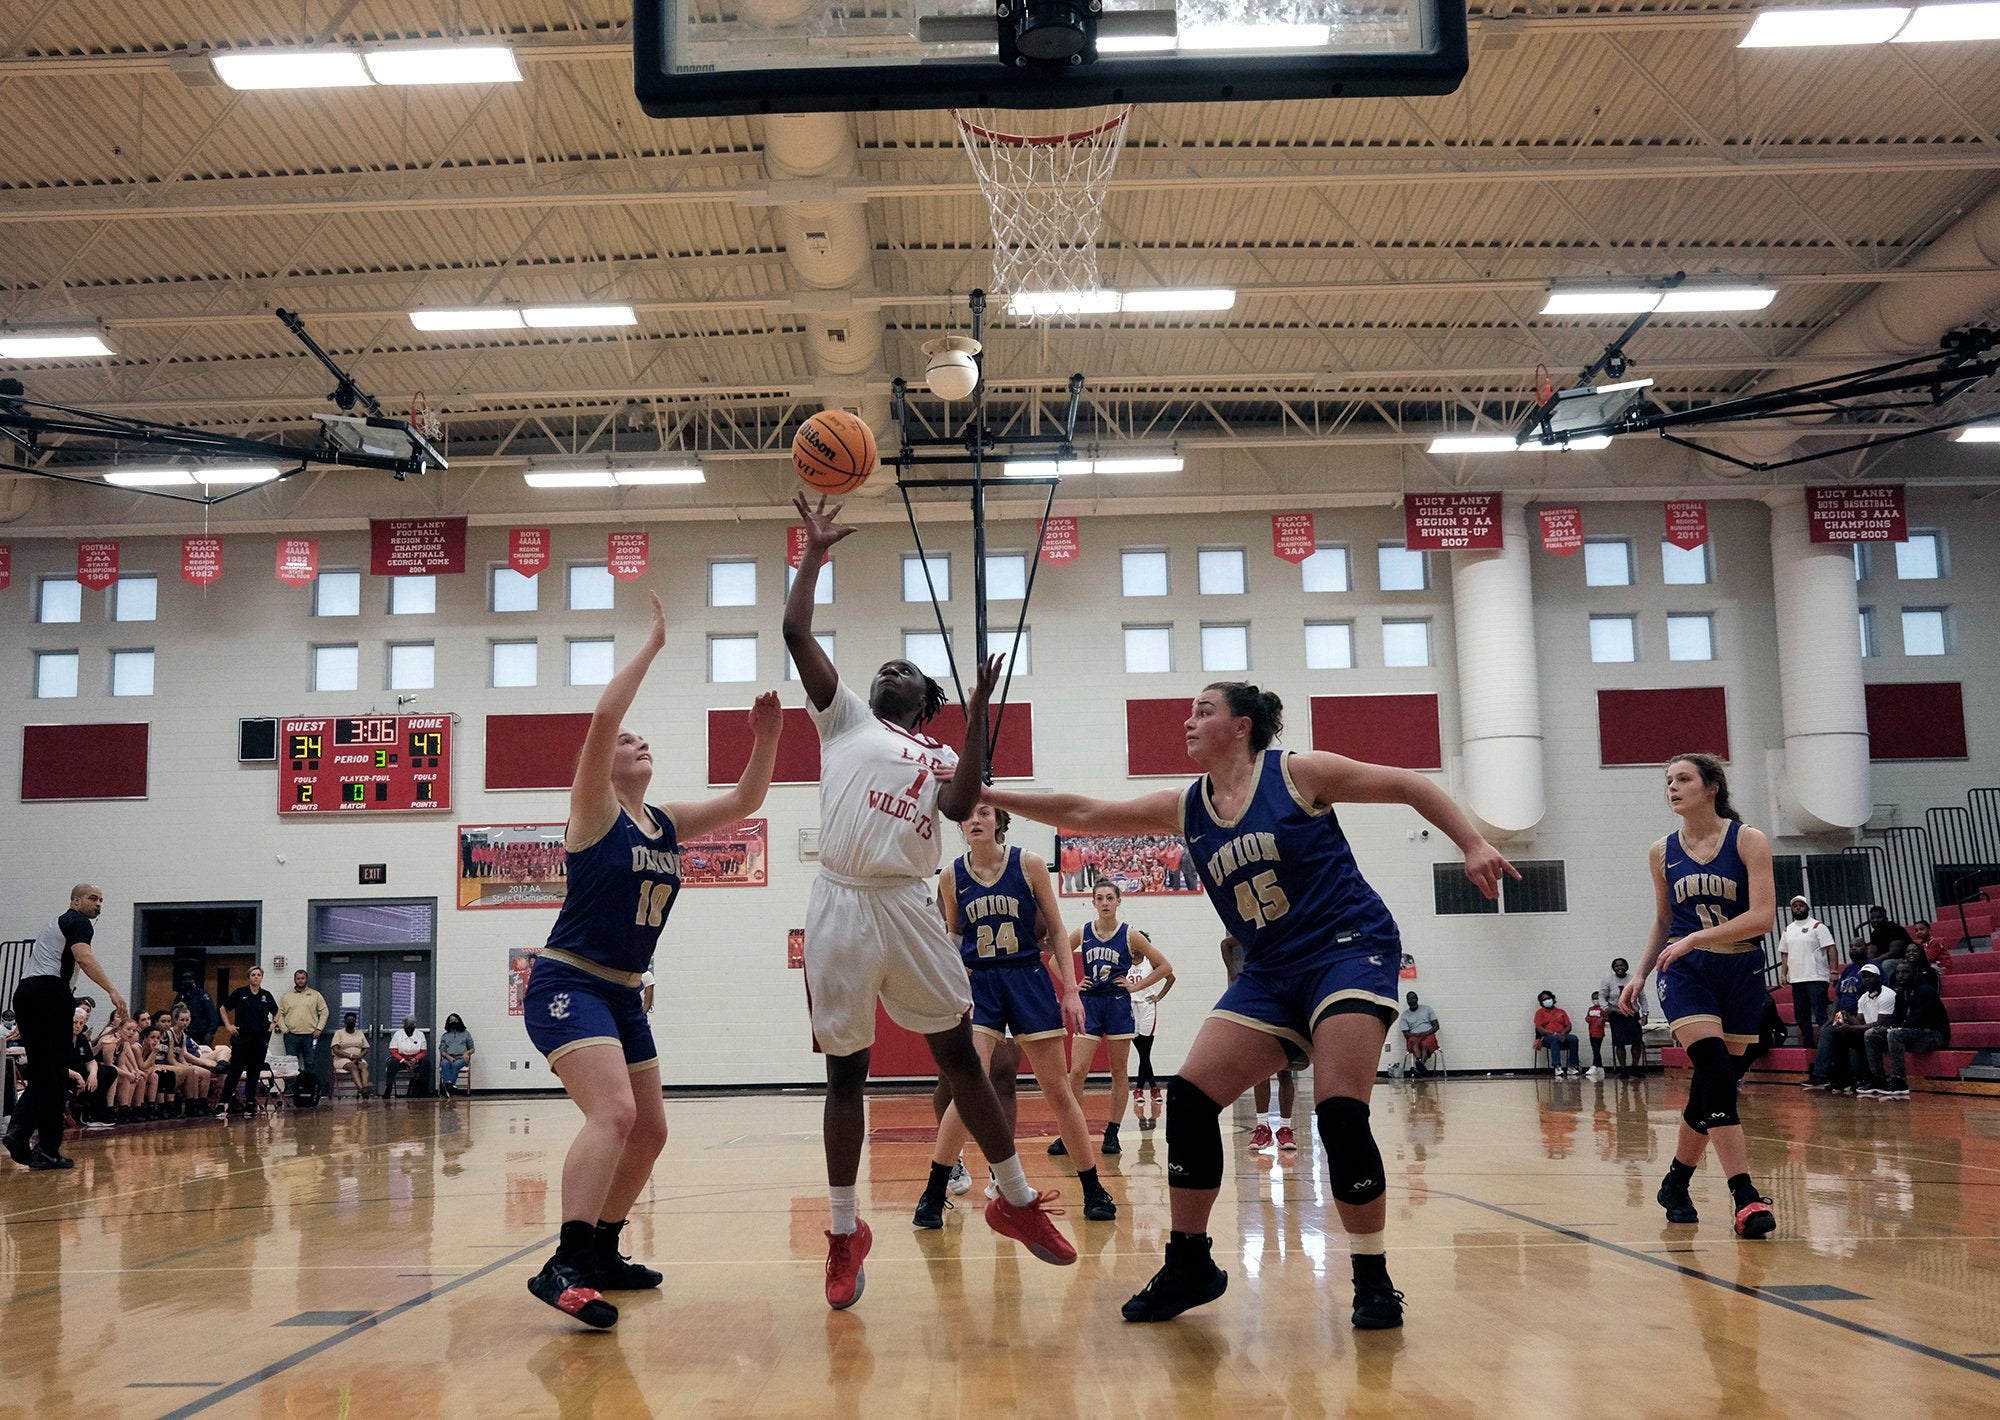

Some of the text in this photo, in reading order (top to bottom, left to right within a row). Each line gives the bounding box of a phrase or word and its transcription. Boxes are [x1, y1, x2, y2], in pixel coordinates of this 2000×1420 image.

[1817, 489, 1893, 499] LUCY LANEY
[1415, 496, 1491, 506] LUCY LANEY
[1817, 500, 1895, 508] BOYS BASKETBALL
[1419, 507, 1488, 516] GIRLS GOLF
[1672, 510, 1699, 518] 3AA
[1814, 510, 1900, 519] REGION 3 AAA
[391, 521, 446, 530] LUCY LANEY
[1416, 517, 1492, 527] REGION 3 AA
[1824, 520, 1891, 529] CHAMPIONS
[1421, 528, 1489, 537] RUNNER-UP
[1549, 528, 1576, 537] 2011
[1677, 531, 1700, 539] 2011
[1829, 530, 1888, 540] 2002-2003
[1441, 538, 1469, 547] 2007
[394, 544, 442, 552] CHAMPIONS
[391, 551, 445, 559] SEMI-FINALS
[1049, 551, 1070, 559] 3AA
[387, 558, 450, 567] GEORGIA DOME
[286, 721, 326, 732] GUEST
[408, 718, 444, 729] HOME
[350, 719, 394, 742] 3:06
[295, 735, 322, 758] 34
[414, 733, 442, 755] 47
[334, 750, 386, 768] PERIOD 3
[902, 748, 942, 770] LAD
[905, 768, 929, 800] 1
[302, 785, 313, 802] 2
[354, 784, 364, 801] 0
[291, 803, 318, 811] POINTS
[340, 802, 367, 810] MATCH
[1207, 832, 1281, 887] UNION
[364, 868, 381, 880] EXIT
[508, 885, 528, 893] 2017
[1673, 873, 1737, 904] UNION
[492, 894, 557, 904] State Champions
[1233, 868, 1290, 930] 45
[965, 895, 1019, 924] UNION
[977, 921, 1018, 958] 24
[1086, 946, 1120, 965] UNION
